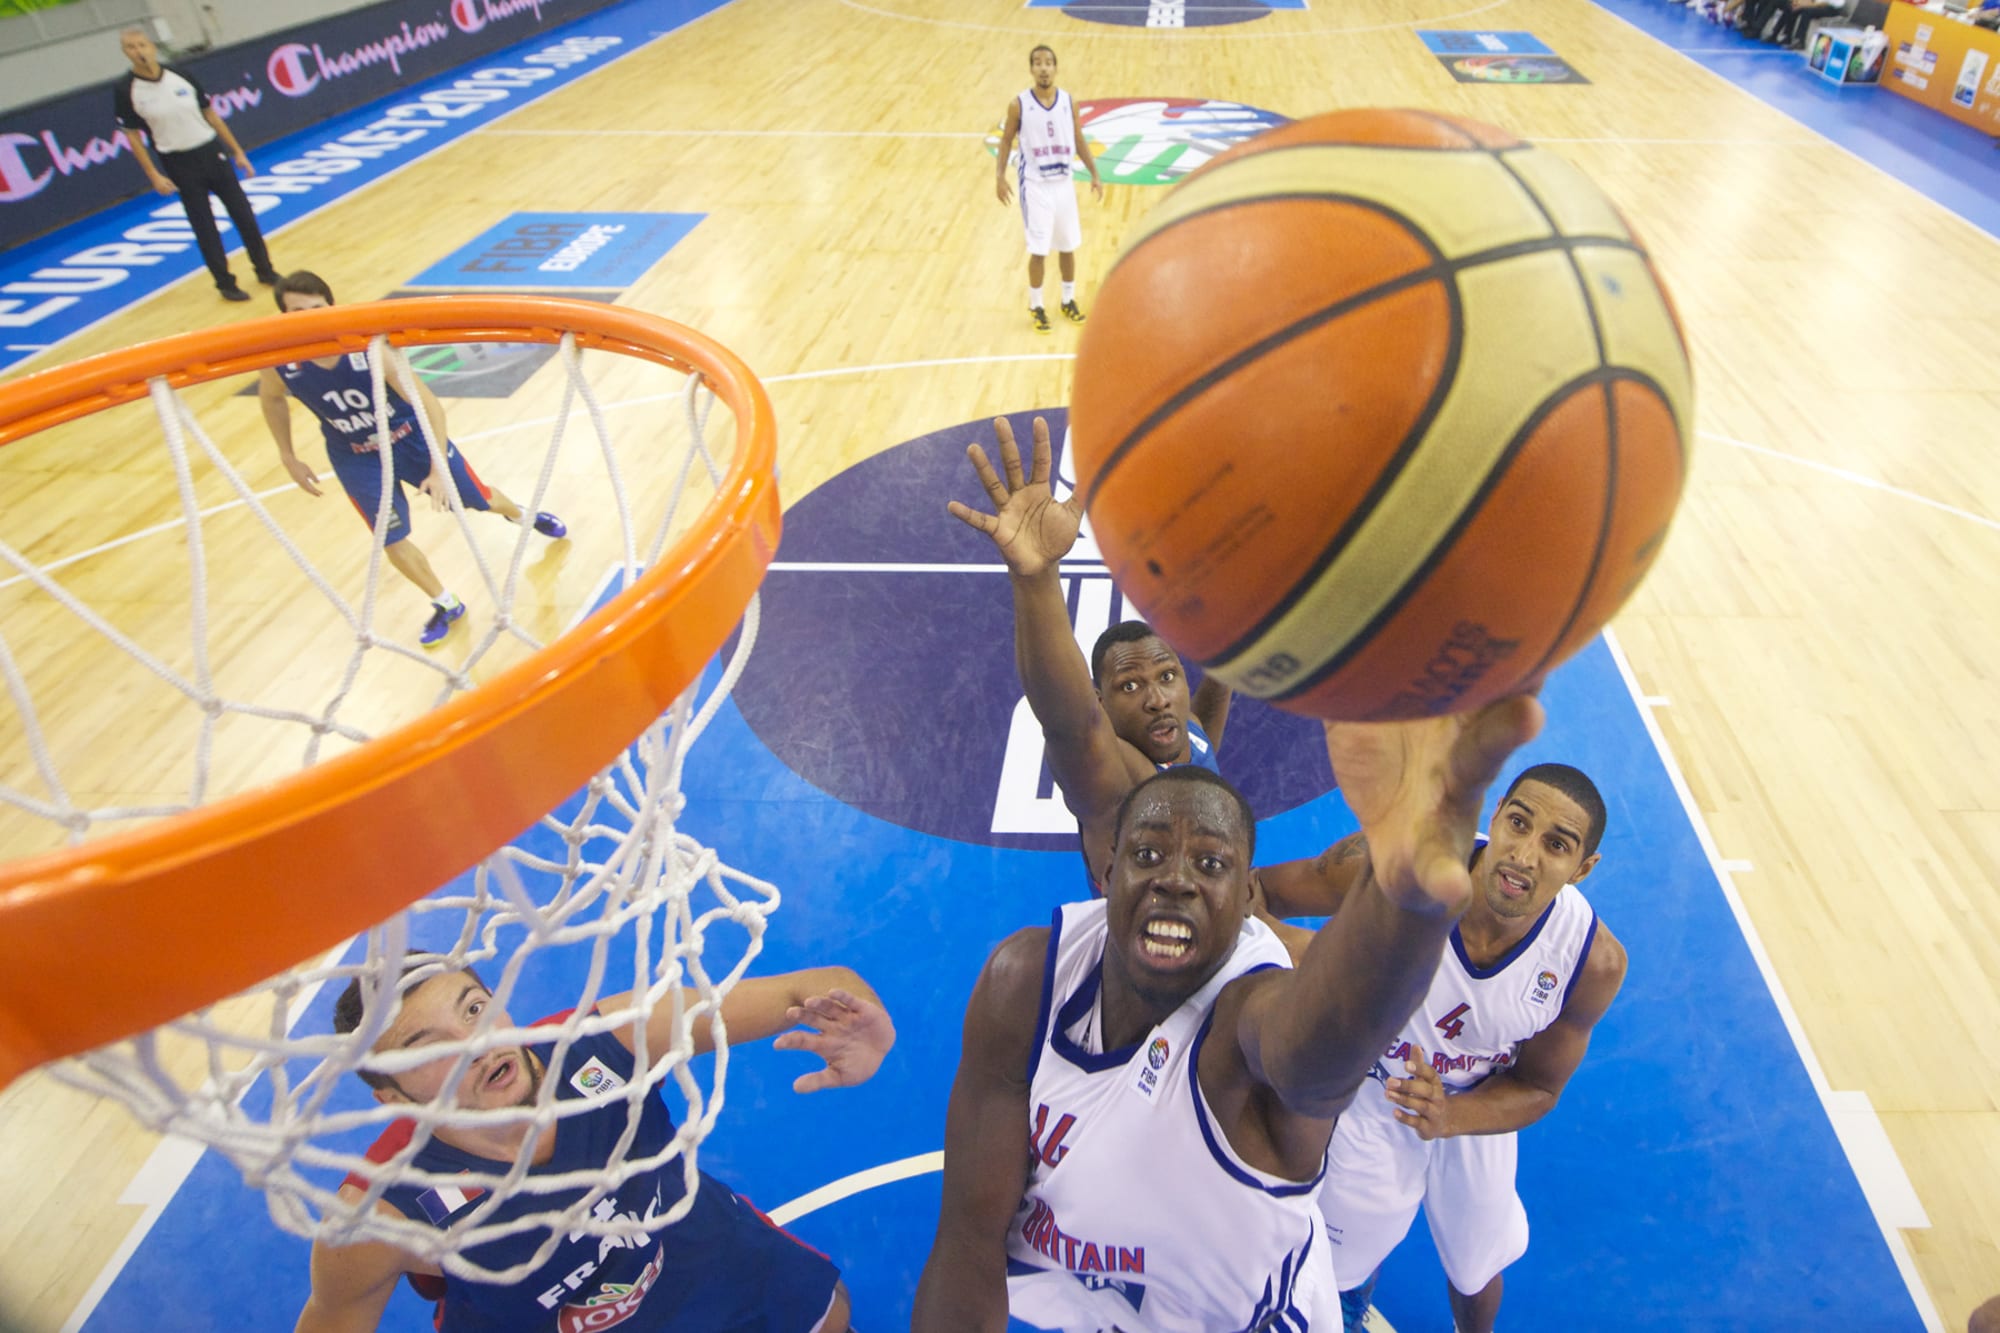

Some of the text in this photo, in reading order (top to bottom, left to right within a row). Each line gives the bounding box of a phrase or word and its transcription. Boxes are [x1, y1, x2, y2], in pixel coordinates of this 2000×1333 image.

[450, 0, 552, 33] Champ
[267, 20, 448, 97] Champion
[458, 223, 587, 273] FIBA
[537, 224, 627, 272] EUROPE
[322, 389, 370, 412] 10
[1435, 1001, 1471, 1041] 4
[595, 1078, 615, 1096] FIBA
[1141, 1066, 1158, 1089] FIBA
[1022, 1196, 1146, 1275] BRITAIN
